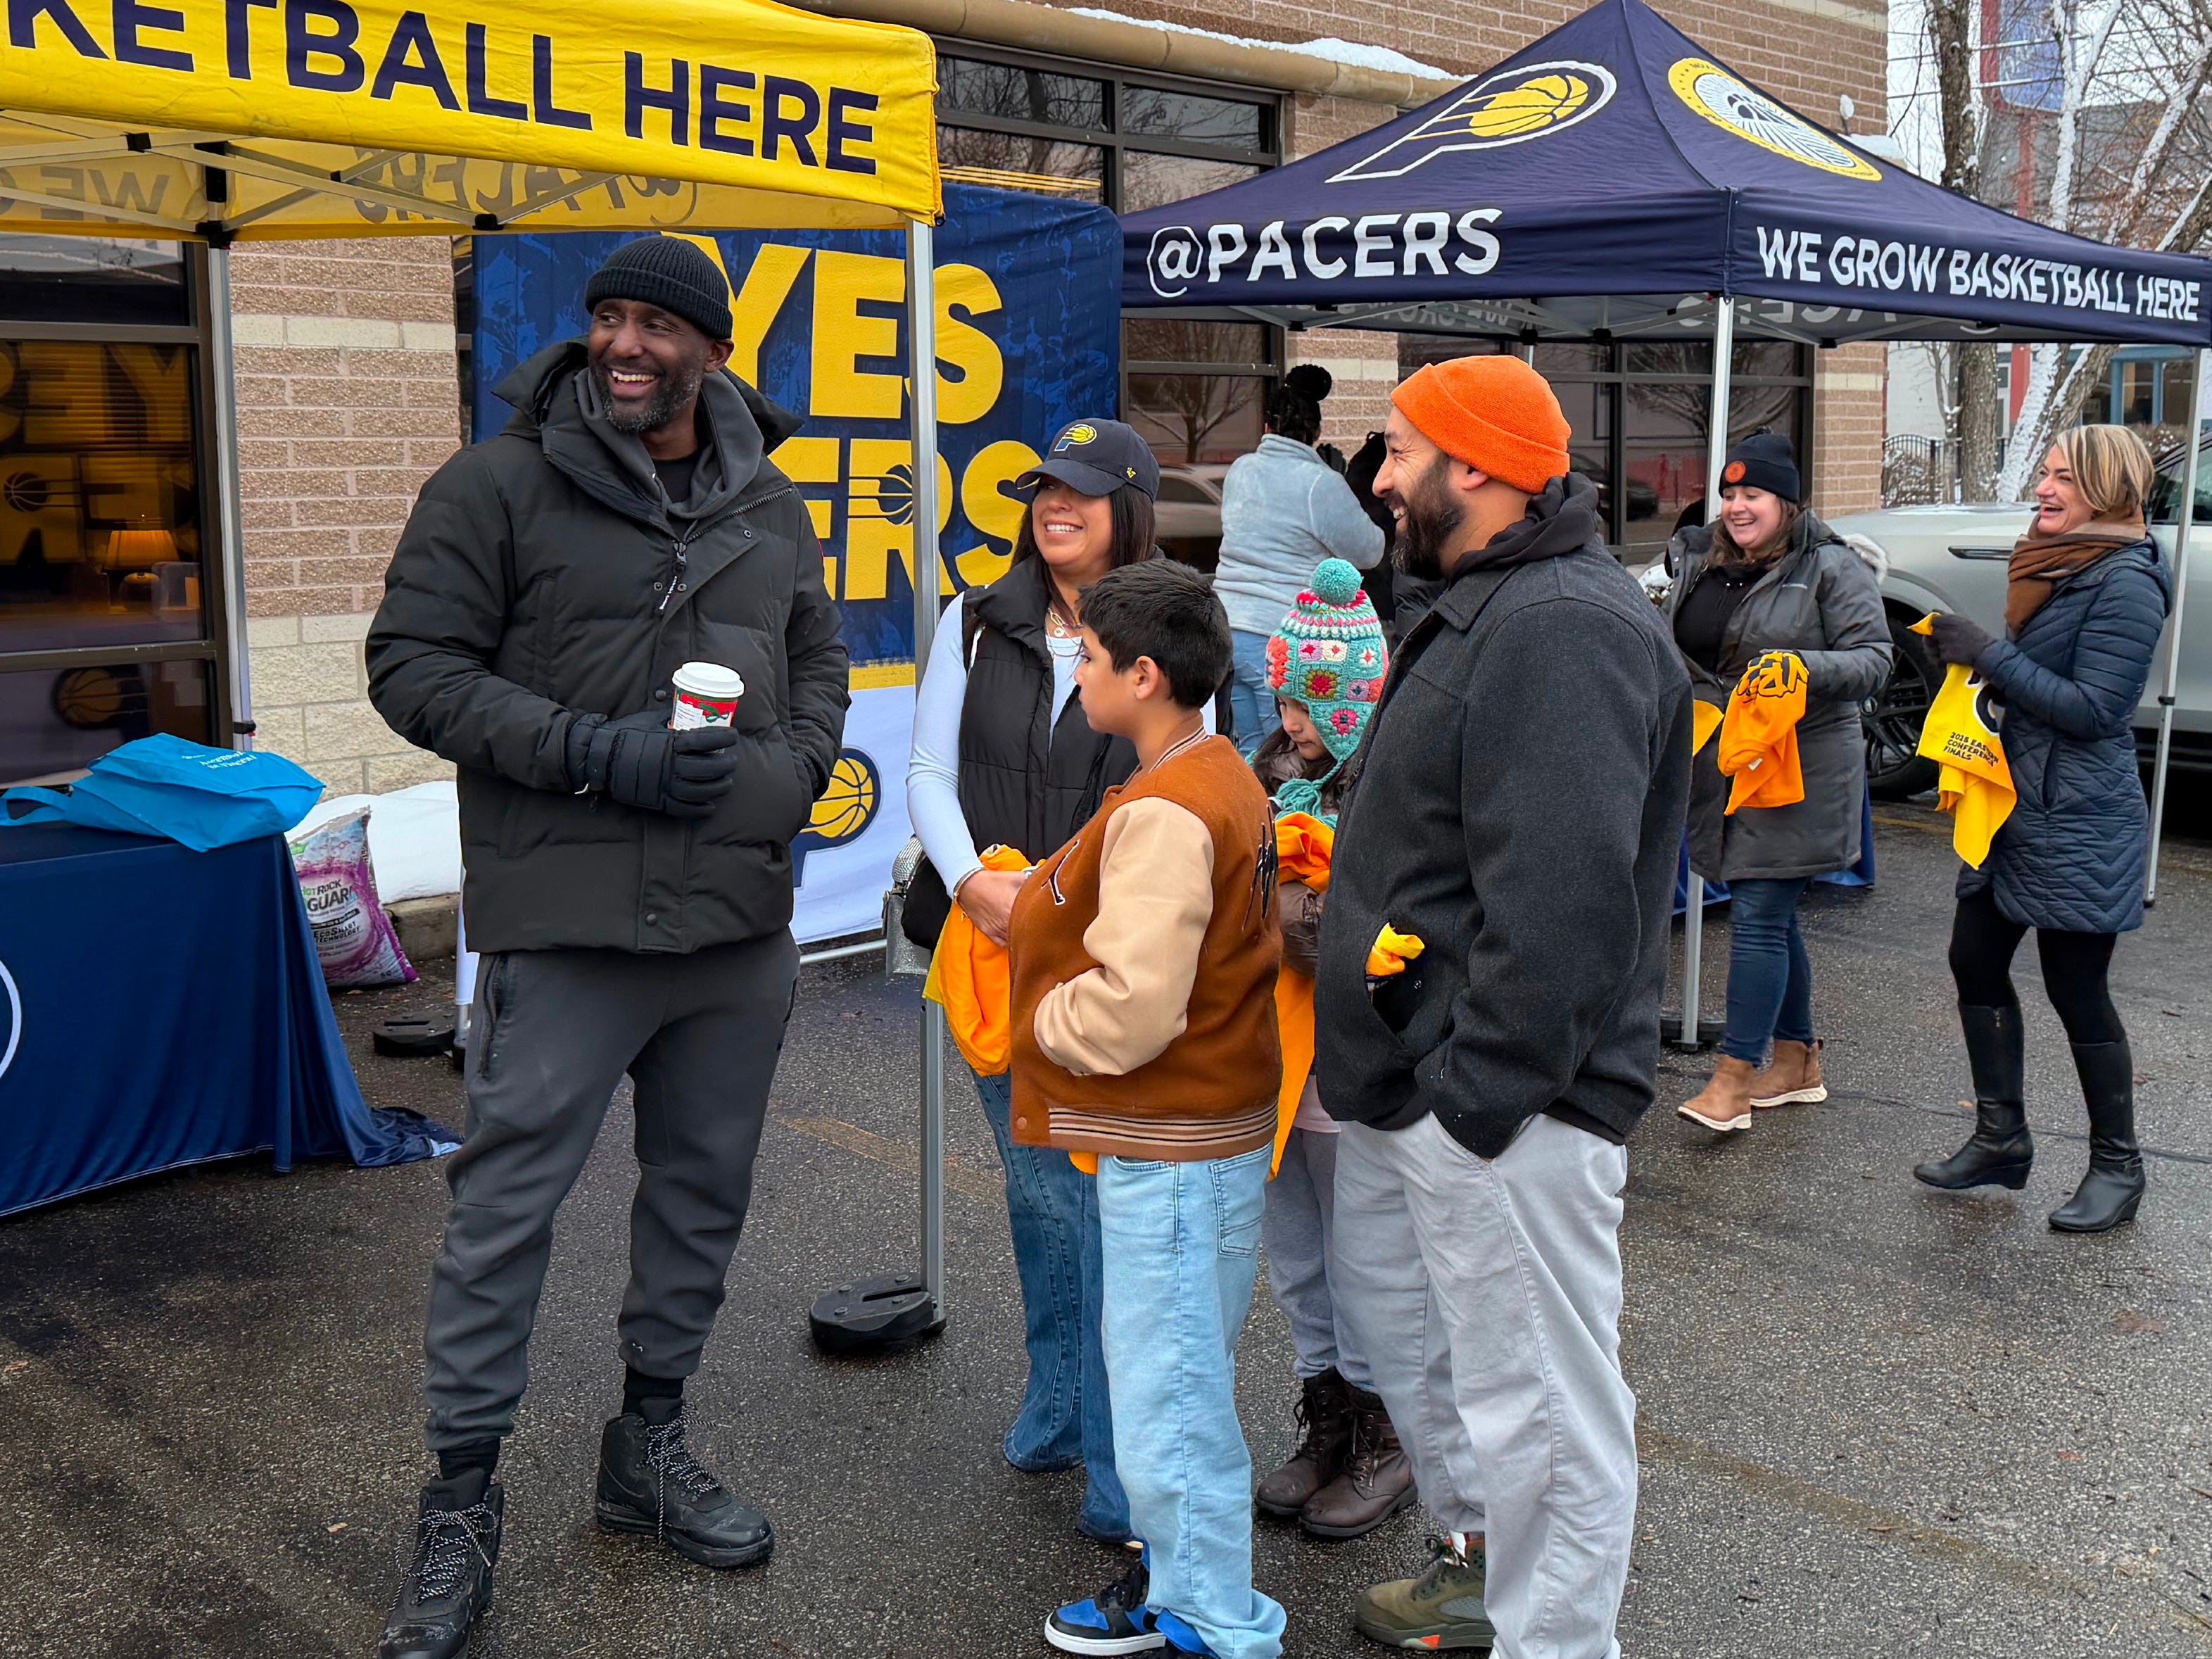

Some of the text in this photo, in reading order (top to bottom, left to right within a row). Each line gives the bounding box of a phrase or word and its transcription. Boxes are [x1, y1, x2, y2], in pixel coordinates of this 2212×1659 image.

[624, 49, 879, 176] HERE
[1146, 208, 1503, 298] @PACERS
[1757, 226, 2201, 322] WE GROW BASKETBALL HERE
[660, 231, 1004, 424] YES
[1943, 745, 1973, 761] FINALS
